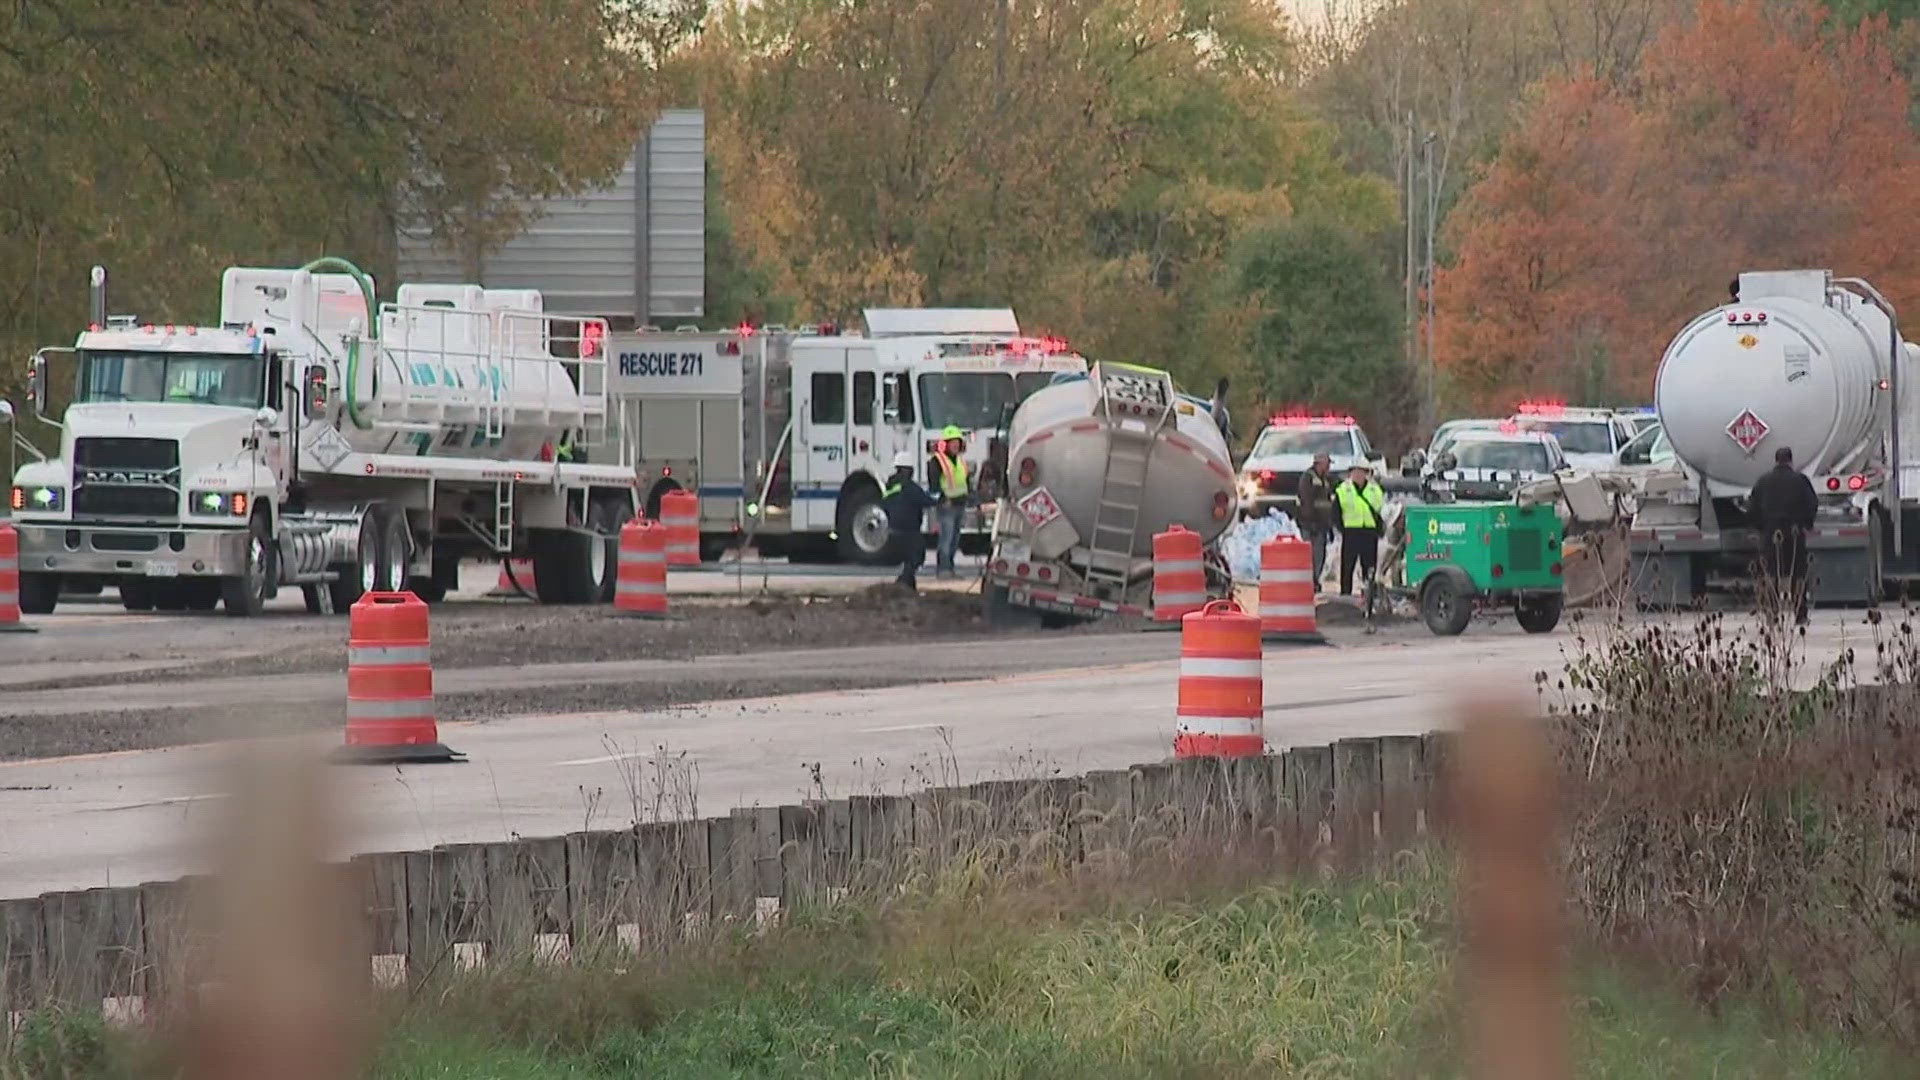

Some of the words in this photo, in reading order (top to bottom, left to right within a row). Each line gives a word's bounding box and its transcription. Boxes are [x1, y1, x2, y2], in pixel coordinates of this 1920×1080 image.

[620, 352, 677, 376] RESCUE
[681, 352, 703, 376] 271
[828, 445, 843, 461] 271
